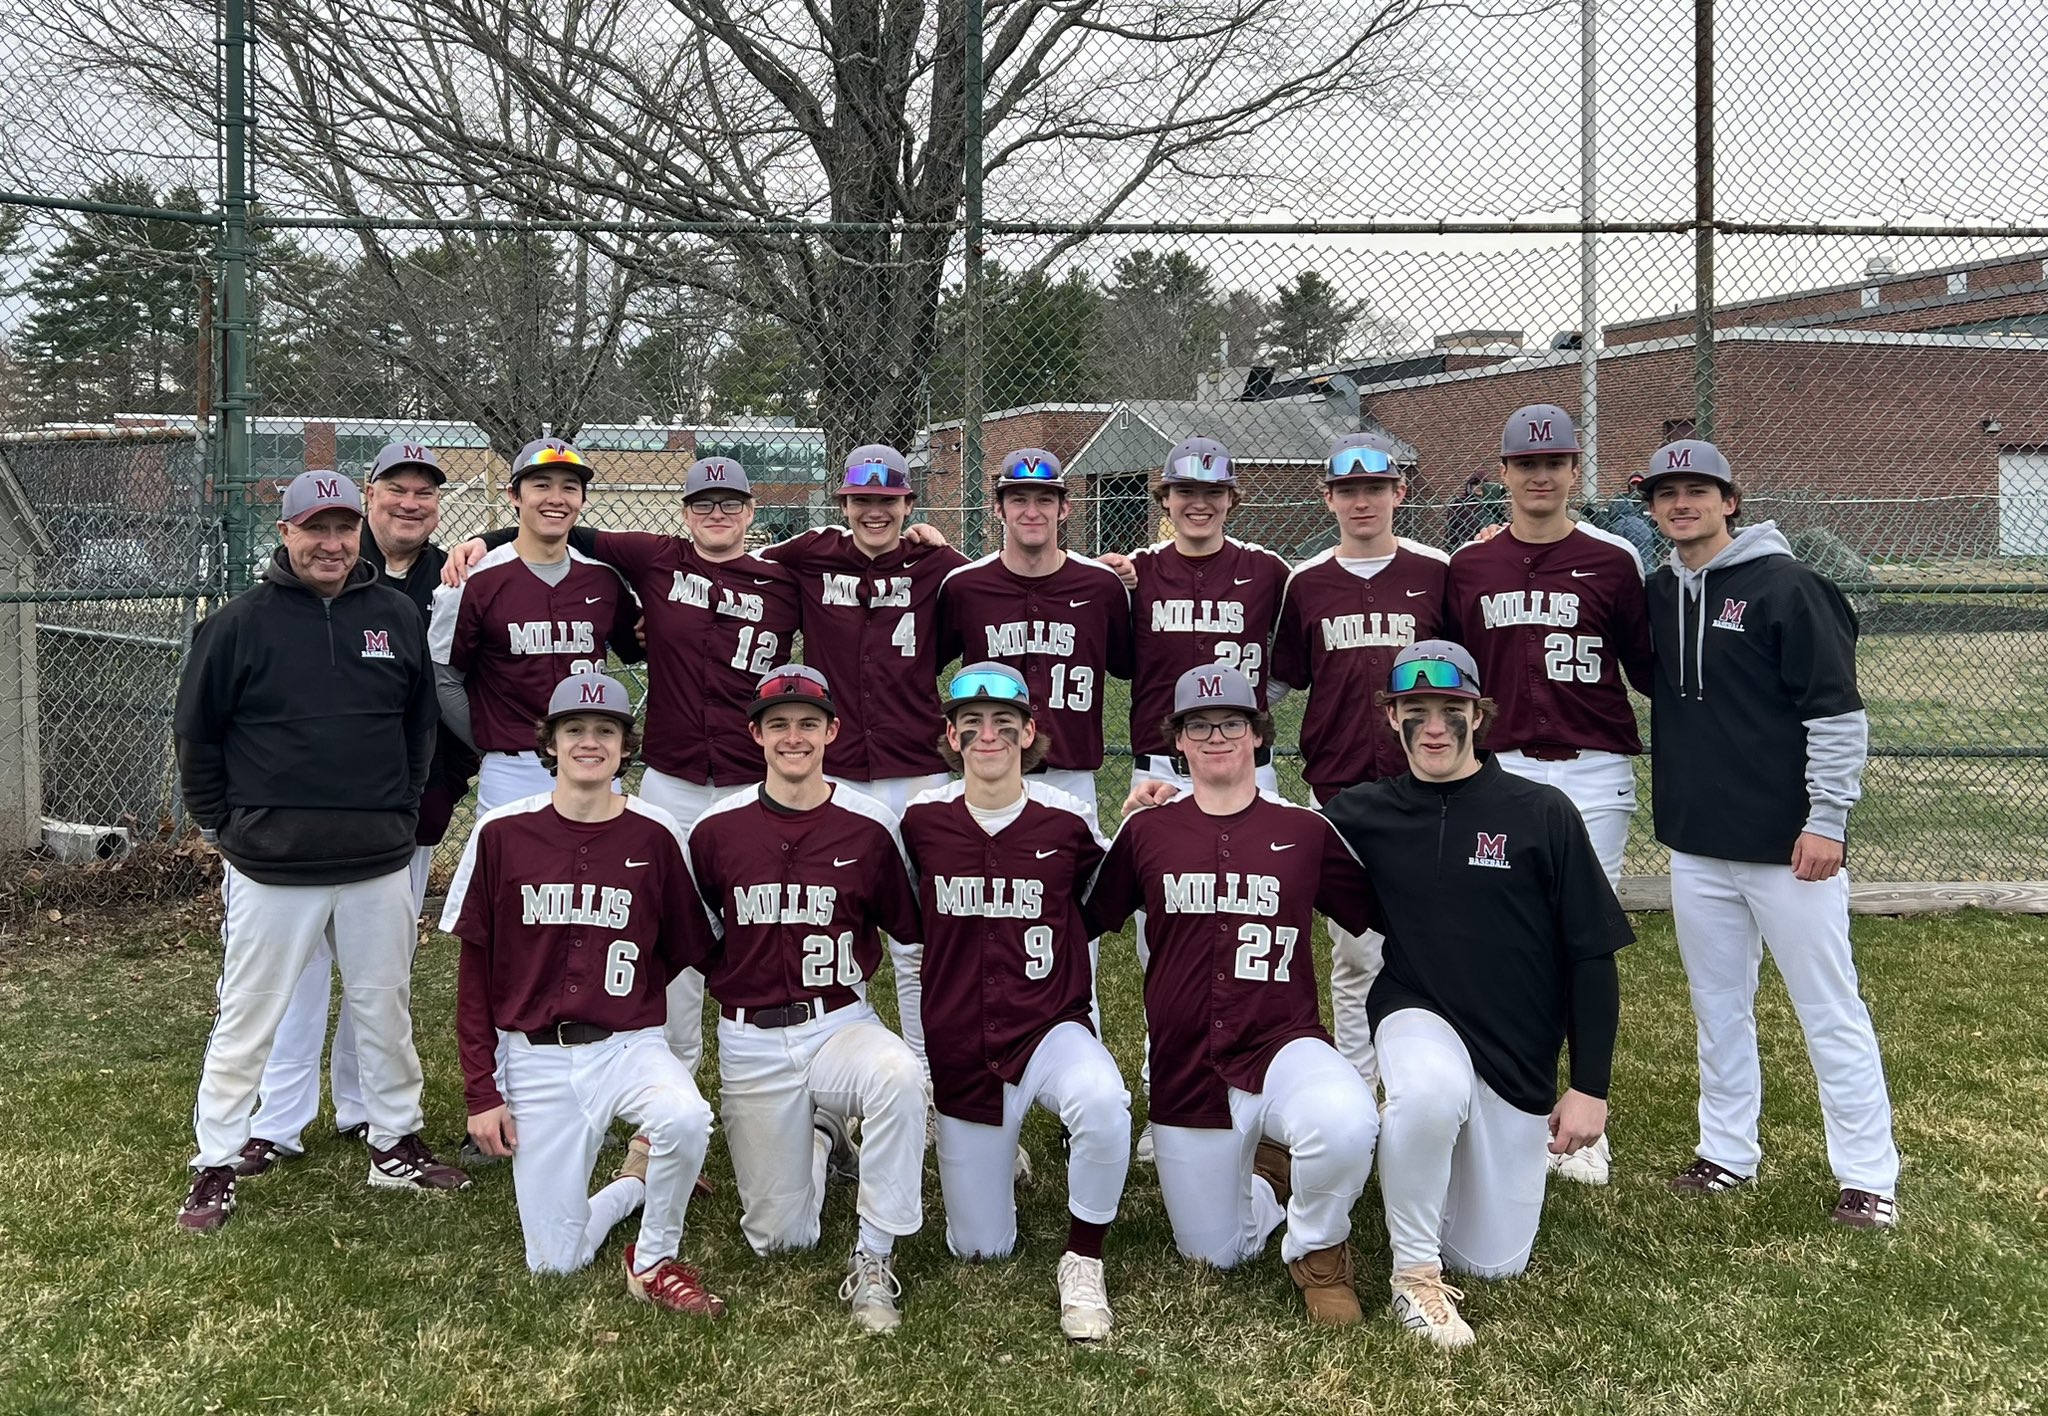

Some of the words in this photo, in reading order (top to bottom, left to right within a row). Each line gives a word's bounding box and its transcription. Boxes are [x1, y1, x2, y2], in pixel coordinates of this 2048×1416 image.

[1528, 420, 1553, 442] M
[403, 444, 424, 460] M
[1667, 448, 1692, 469] M
[315, 478, 341, 498] M
[705, 464, 725, 481] M
[1152, 600, 1244, 633] MILLIS
[1480, 590, 1579, 629] MILLIS
[1719, 598, 1747, 623] M
[363, 630, 389, 651] M
[508, 621, 595, 655] MILLIS
[731, 626, 777, 675] 12
[892, 612, 916, 657] 4
[986, 621, 1075, 658] MILLIS
[1321, 613, 1416, 651] MILLIS
[1214, 641, 1262, 686] 22
[1544, 633, 1604, 683] 25
[579, 683, 605, 704] M
[1049, 663, 1094, 711] 13
[1195, 675, 1224, 698] M
[1468, 856, 1511, 869] BASEBALL
[1475, 832, 1507, 859] M
[521, 883, 632, 929] MILLIS
[733, 883, 836, 926] MILLIS
[935, 876, 1043, 918] MILLIS
[1163, 873, 1280, 916] MILLIS
[604, 940, 640, 997] 6
[802, 931, 863, 987] 20
[1024, 925, 1054, 979] 9
[1234, 923, 1299, 982] 27
